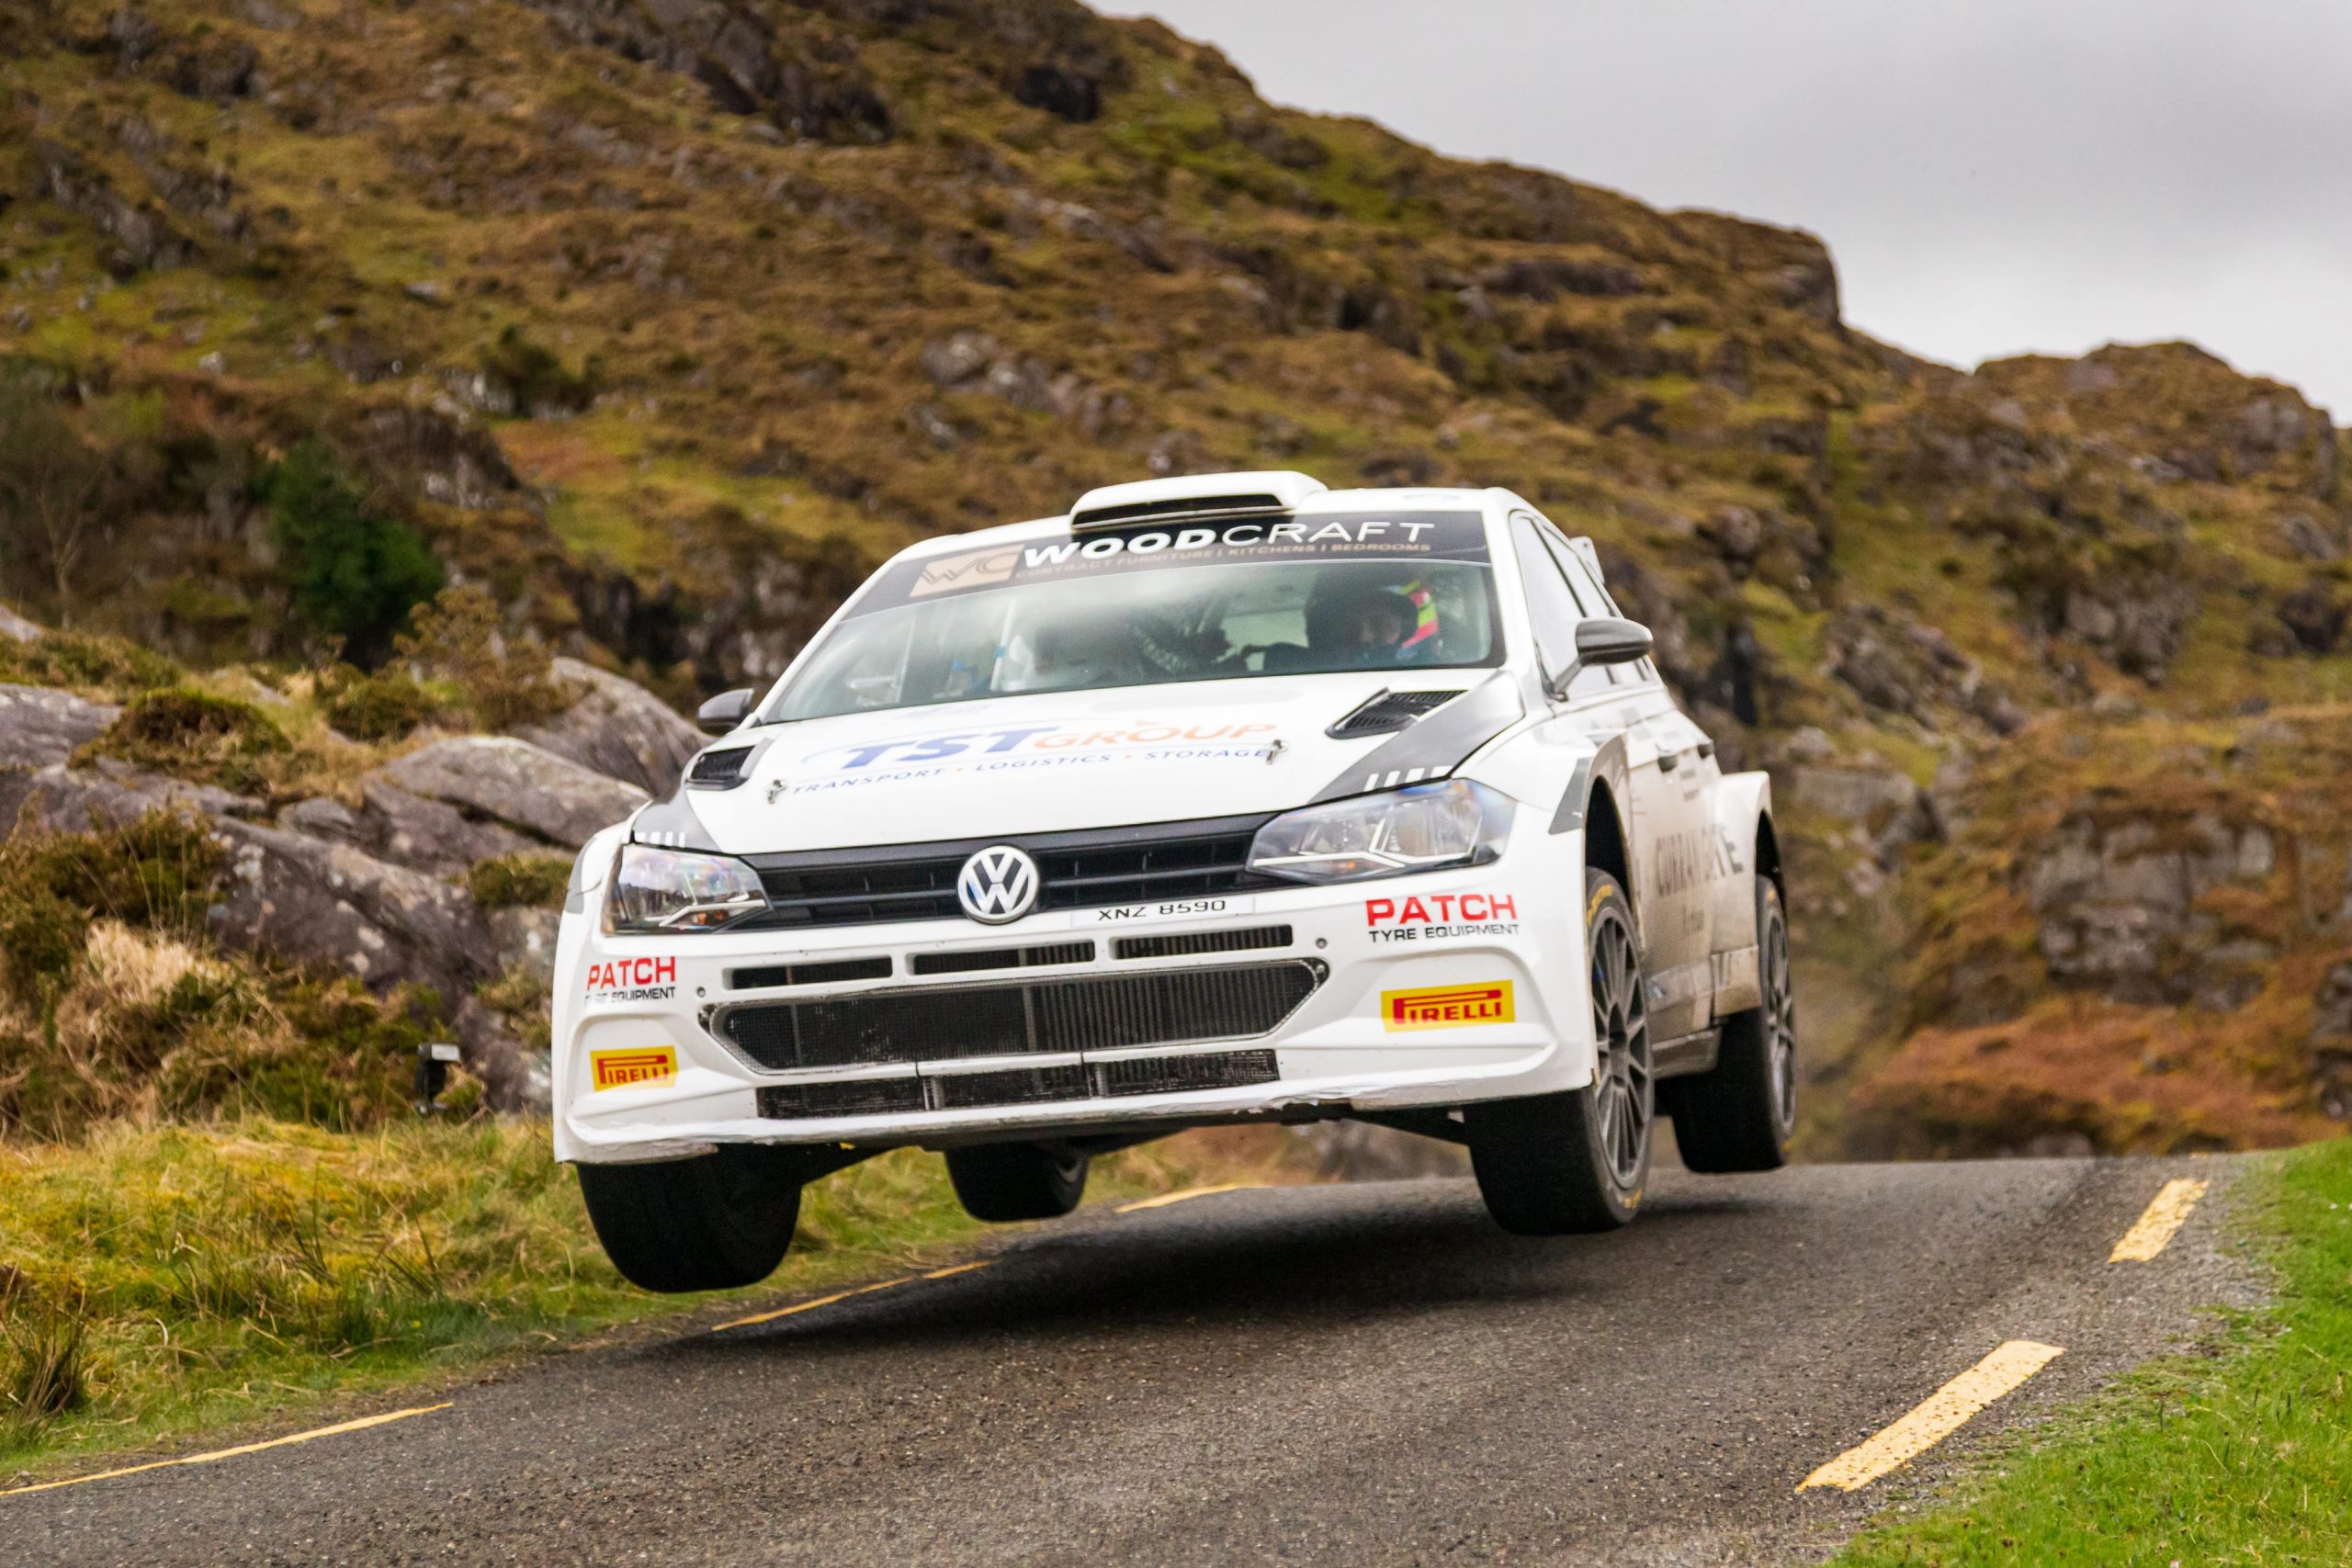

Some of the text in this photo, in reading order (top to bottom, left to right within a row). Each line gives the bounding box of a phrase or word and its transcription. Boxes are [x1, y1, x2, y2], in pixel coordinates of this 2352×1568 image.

[1015, 542, 1432, 579] CONTRACT FURNITURE KITCHENS BEDROOMS
[1024, 521, 1435, 568] WOODCRAFT
[793, 749, 1268, 795] TRANSPORT LOGISTICS STORAGE
[958, 846, 1038, 921] VW
[1098, 899, 1227, 921] XNZ 8590
[1365, 893, 1519, 927] PATCH
[1369, 923, 1520, 943] TYRE EQUIPMENT
[586, 955, 676, 991] PATCH
[1393, 988, 1503, 1025] PIRELLI
[597, 1054, 670, 1085] PIRELLI
